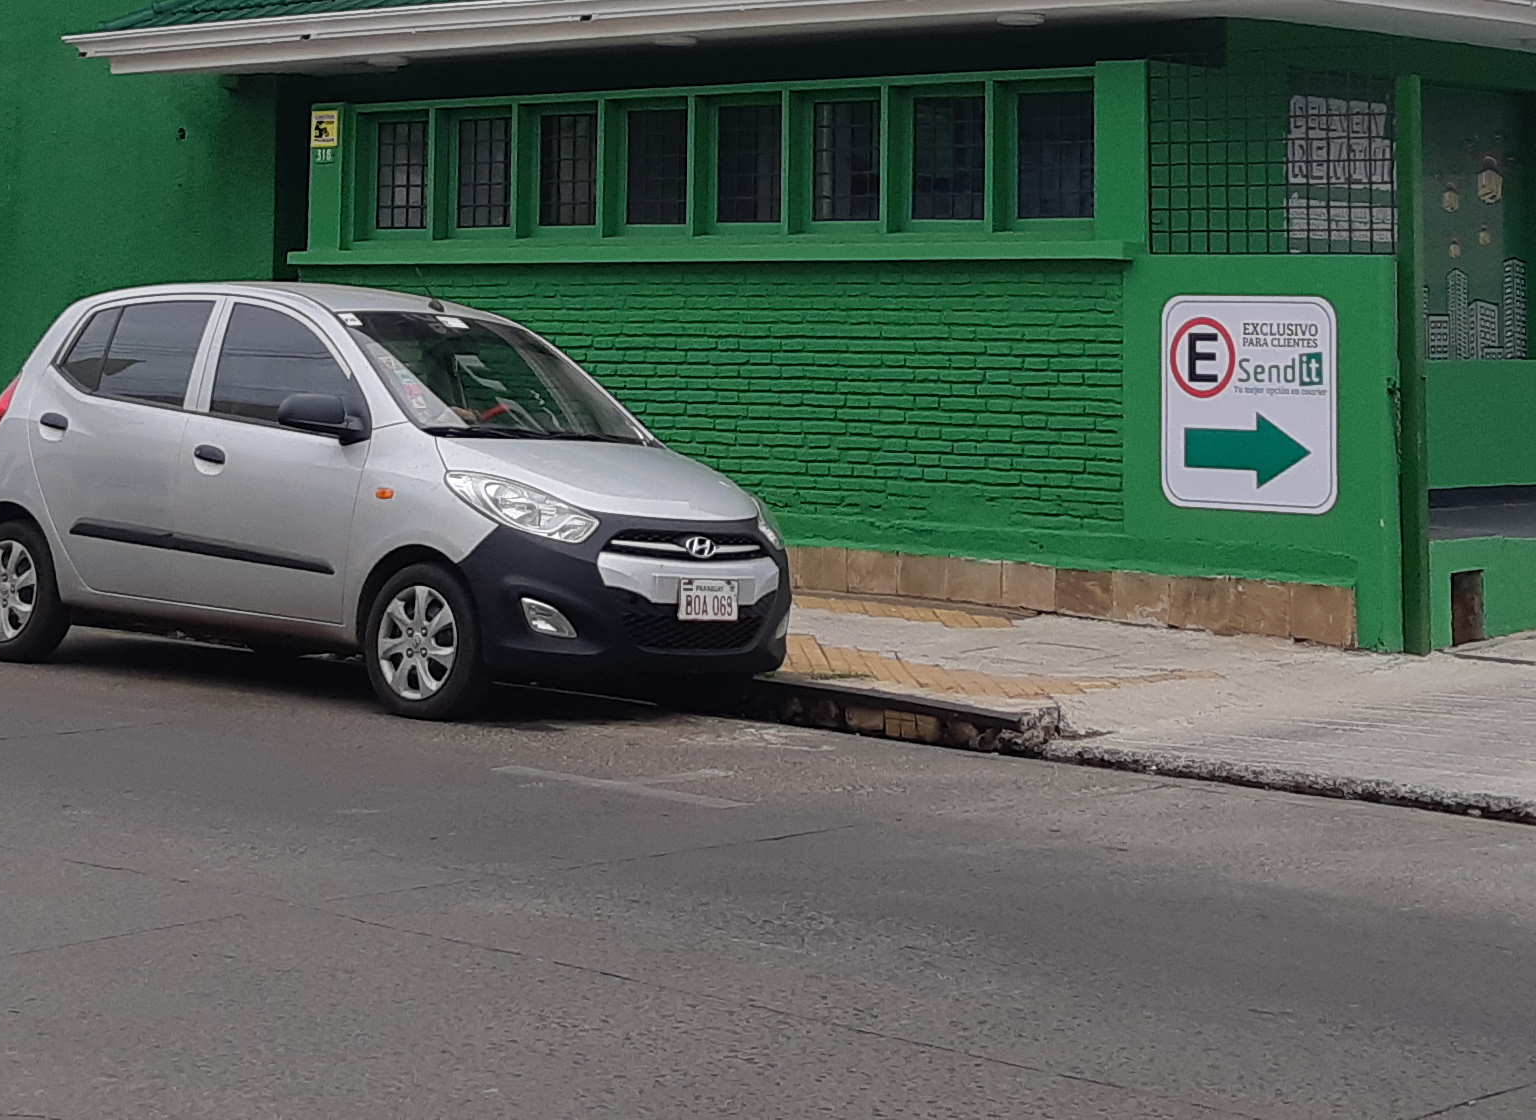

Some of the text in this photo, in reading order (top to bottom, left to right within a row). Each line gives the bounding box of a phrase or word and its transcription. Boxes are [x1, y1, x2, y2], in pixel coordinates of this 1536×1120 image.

[1242, 322, 1319, 337] EXCLUSIVO
[1242, 338, 1319, 349] PARA CLIENTES
[1188, 332, 1218, 382] E
[1237, 353, 1322, 385] Sendit
[685, 594, 733, 617] BOA 069
